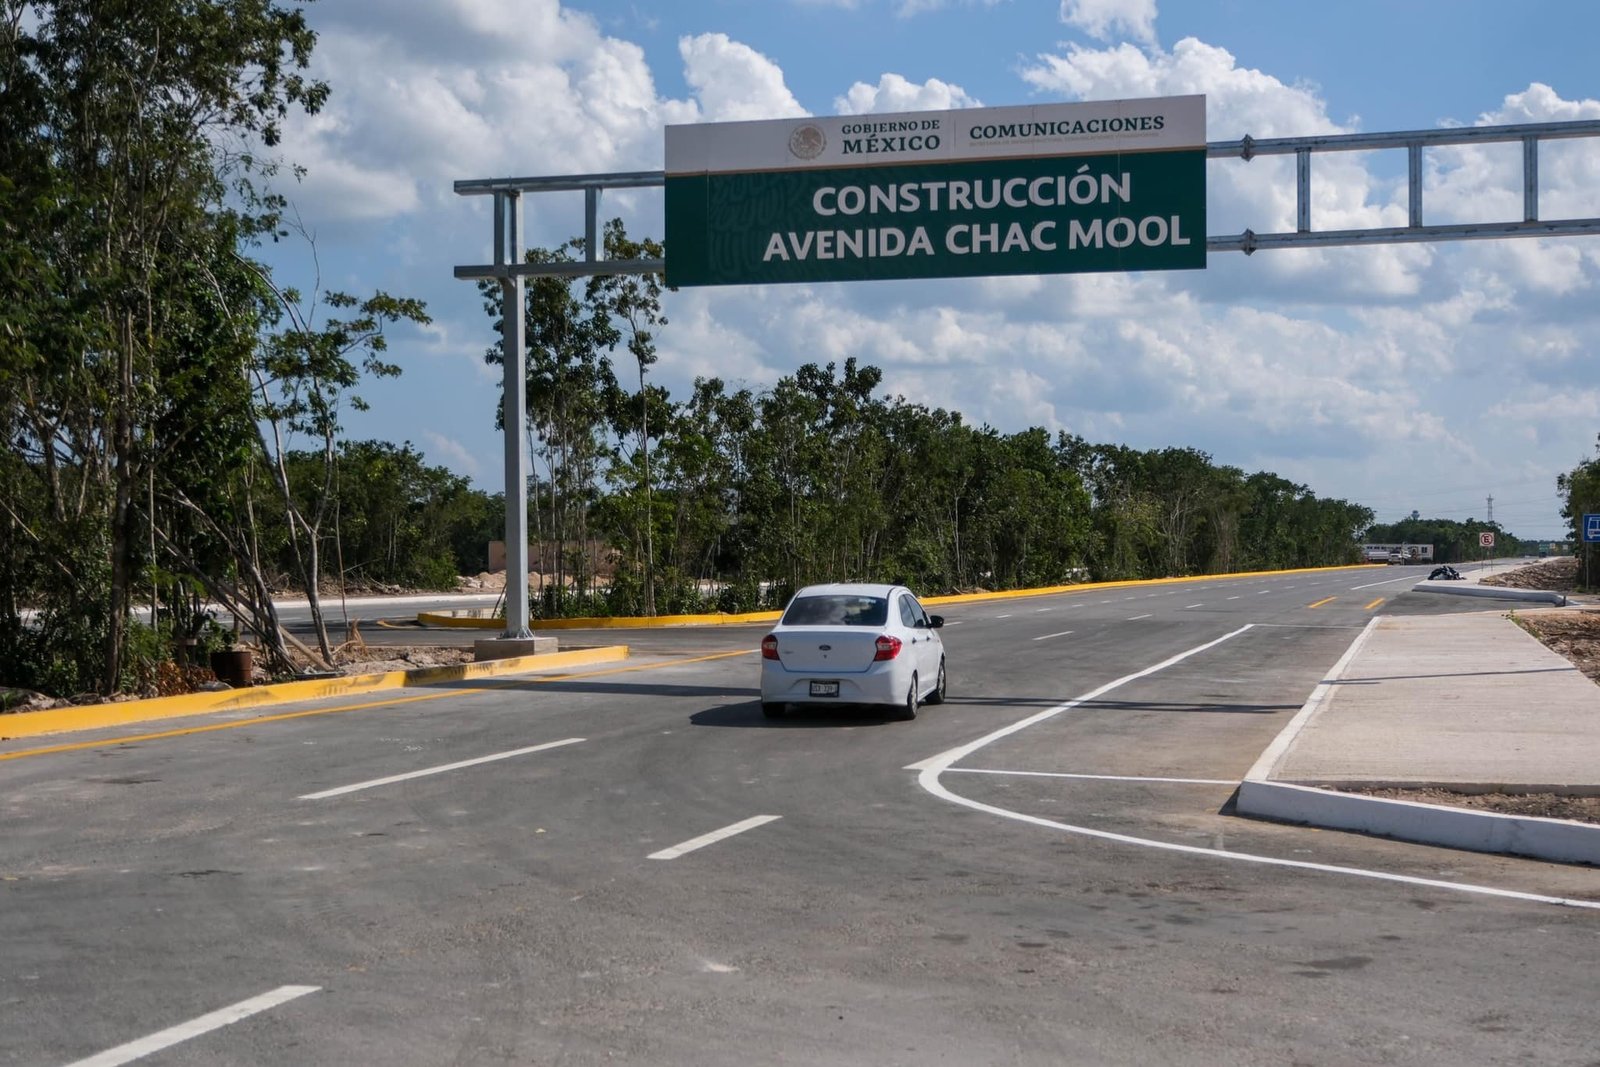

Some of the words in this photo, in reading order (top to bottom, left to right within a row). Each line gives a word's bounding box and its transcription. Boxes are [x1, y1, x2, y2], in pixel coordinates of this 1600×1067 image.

[841, 121, 918, 135] GOBIERNO
[921, 119, 940, 130] DE
[969, 115, 1165, 140] COMUNICACIONES
[842, 133, 941, 155] MÉXICO
[812, 164, 1131, 216] CONSTRUCCIÓN
[762, 226, 935, 262] AVENIDA
[945, 220, 1057, 254] CHAC
[1069, 215, 1191, 250] MOOL
